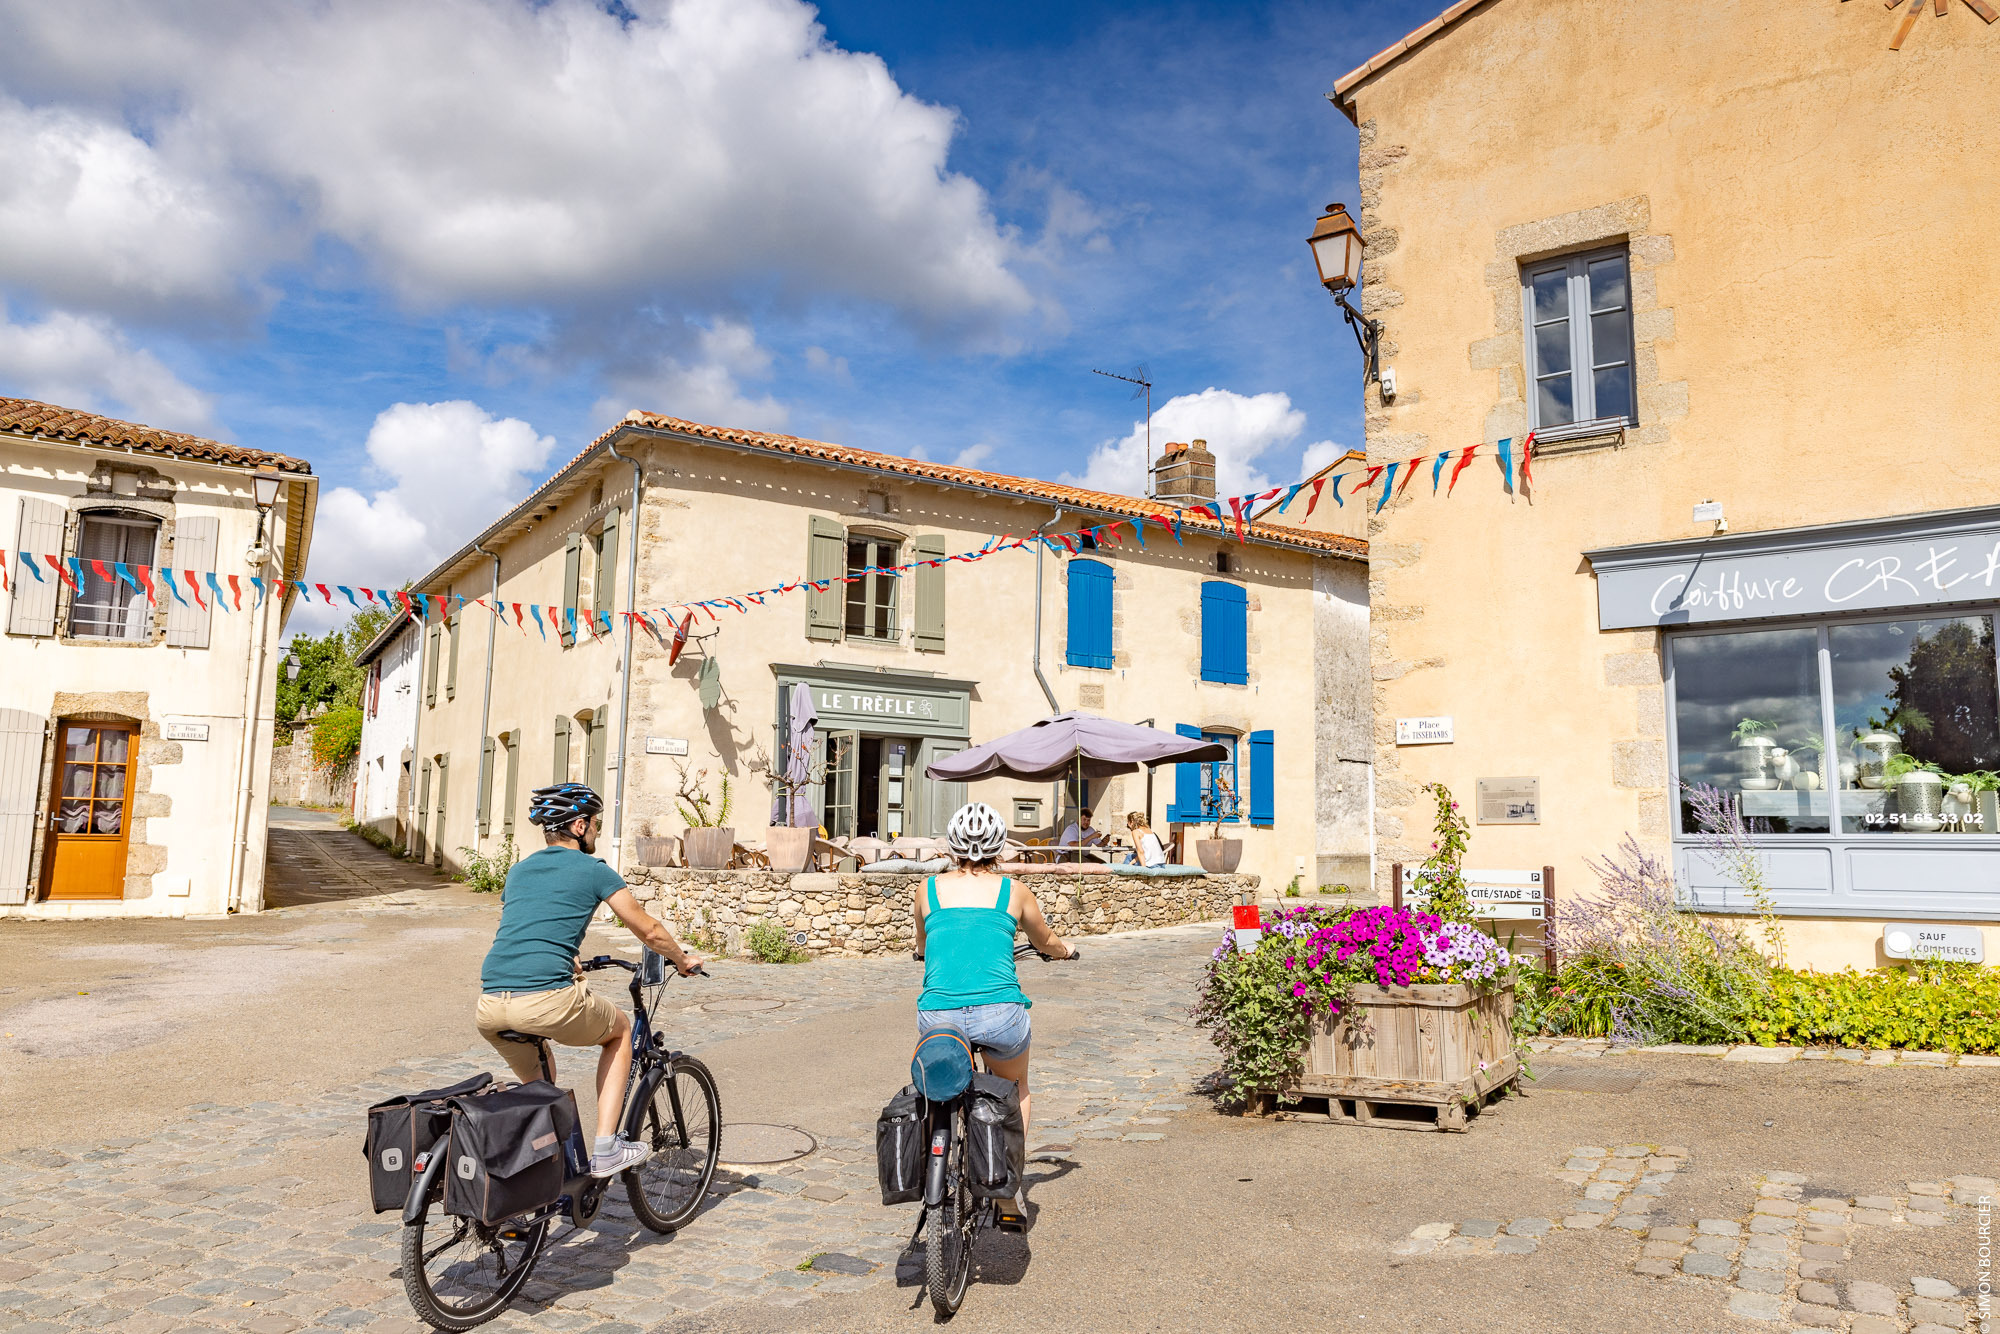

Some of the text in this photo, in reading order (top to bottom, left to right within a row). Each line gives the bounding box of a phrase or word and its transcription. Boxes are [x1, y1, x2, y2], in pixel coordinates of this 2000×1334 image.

[1651, 571, 1803, 617] Coiffure
[822, 693, 915, 715] LE TRÈFLE
[1419, 721, 1440, 729] Place
[1412, 730, 1449, 739] TISSERANDS
[1865, 813, 1984, 824] 02 51 65 33 02
[1919, 932, 1947, 941] SAUF
[1916, 944, 1977, 956] COMMERCES
